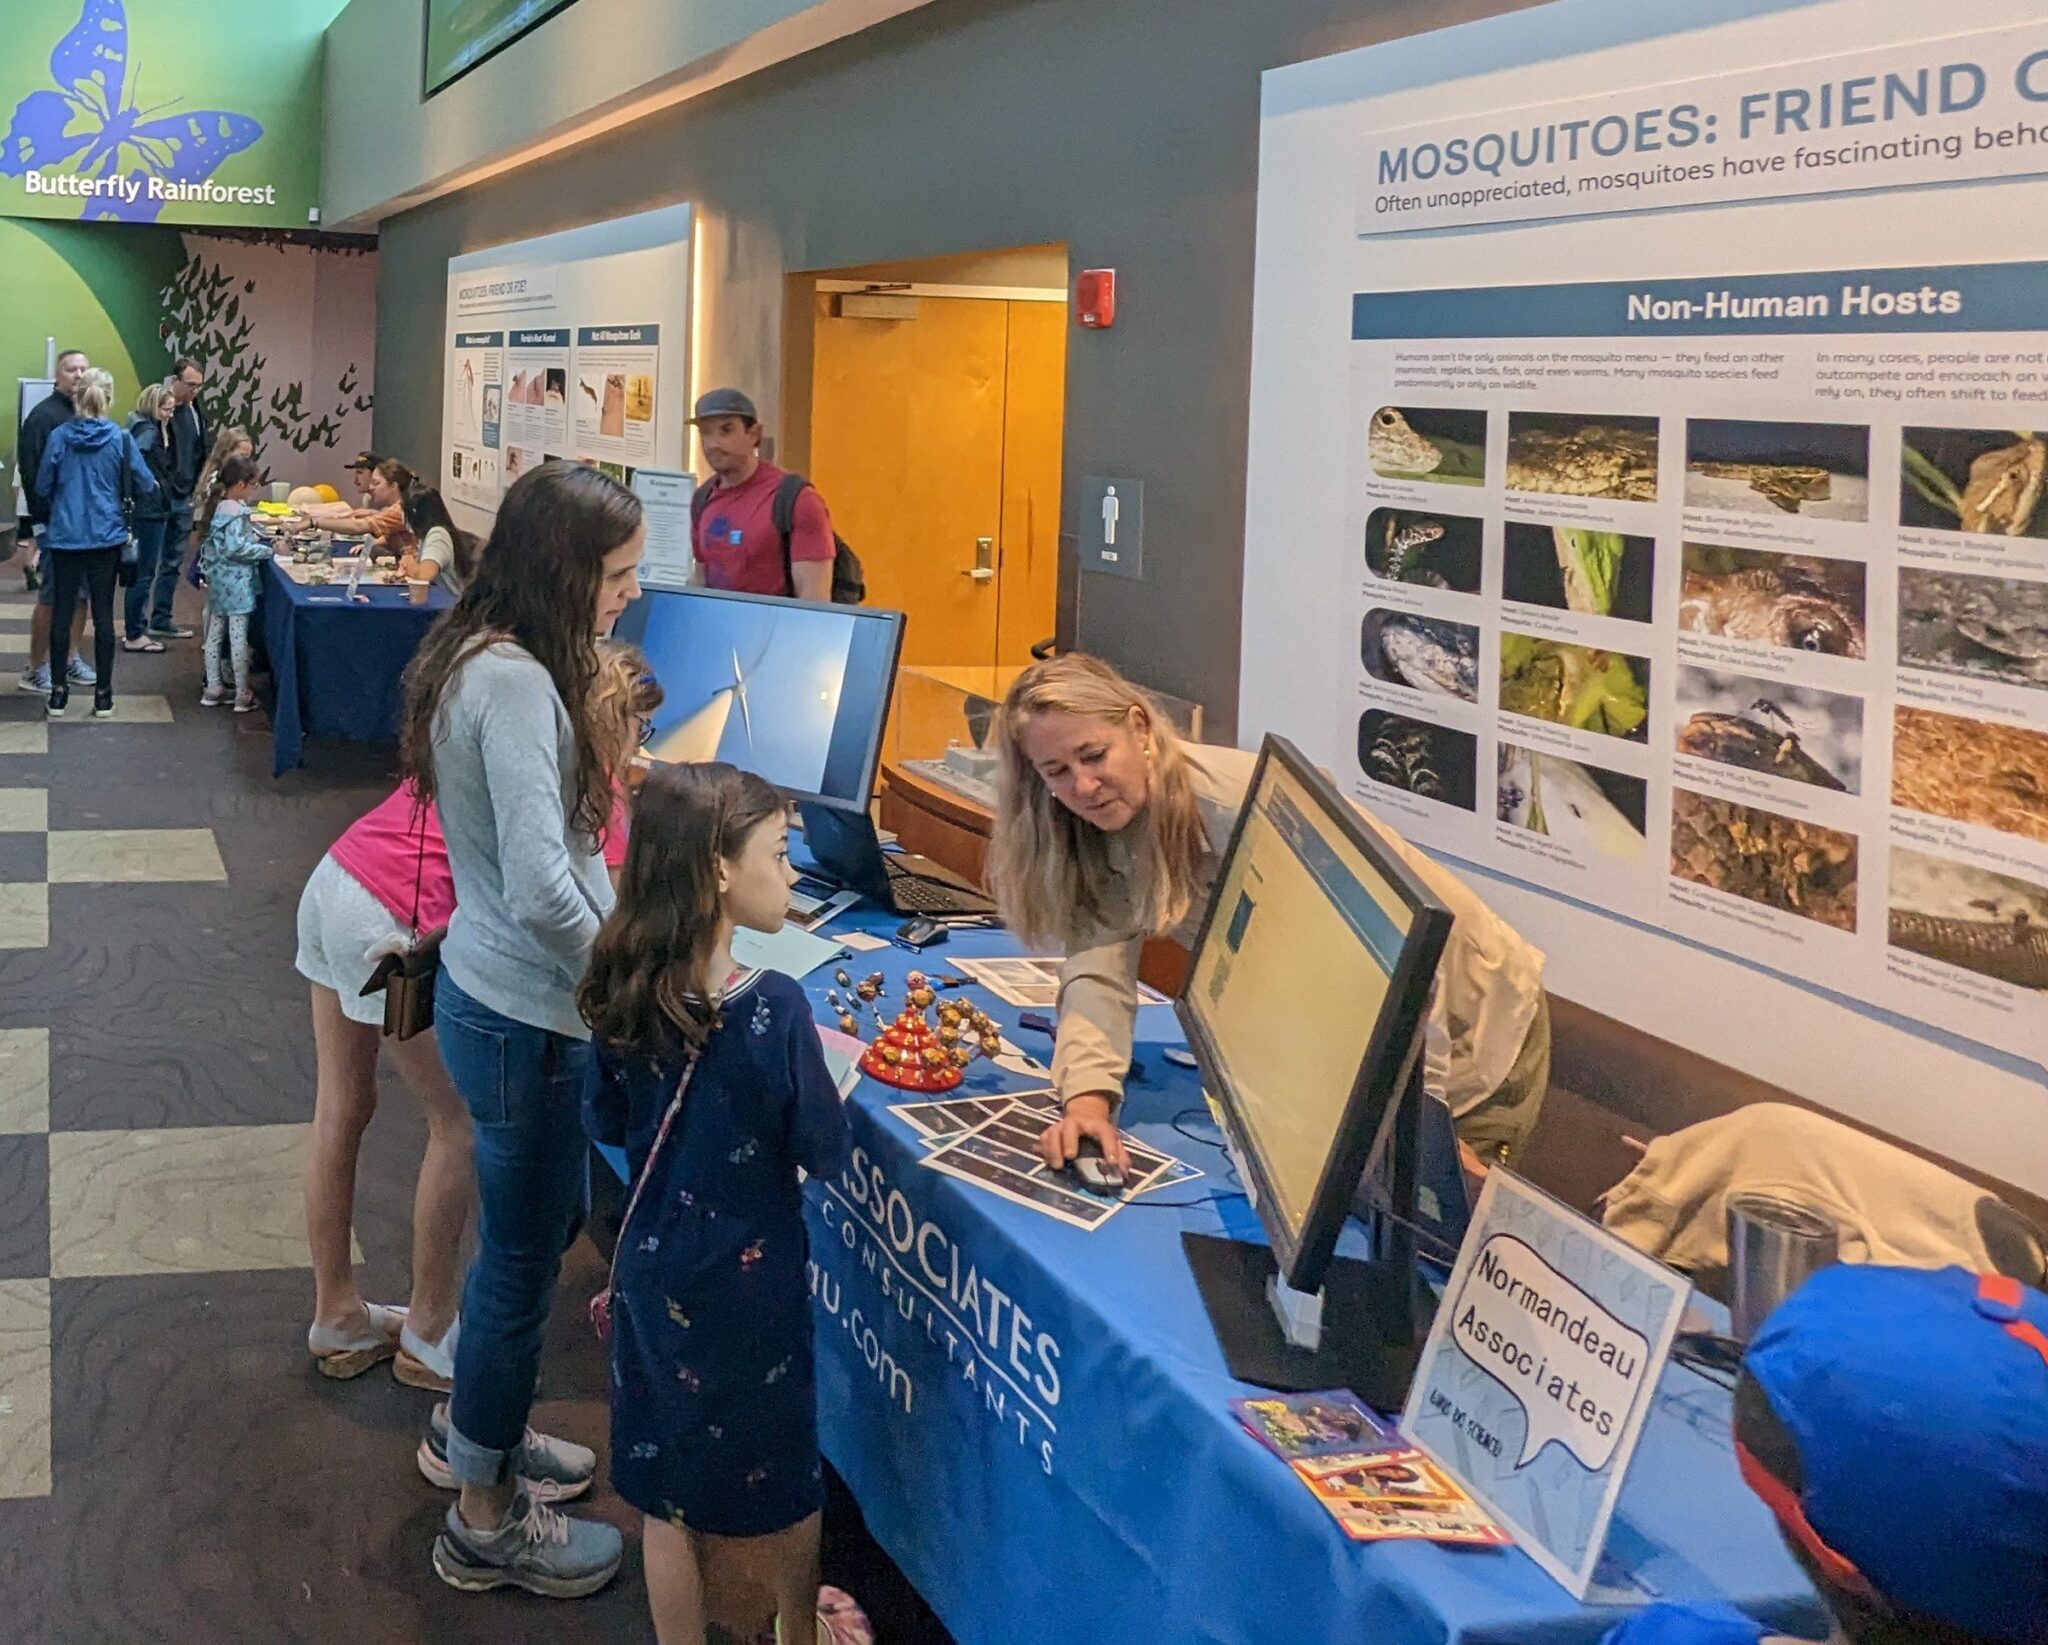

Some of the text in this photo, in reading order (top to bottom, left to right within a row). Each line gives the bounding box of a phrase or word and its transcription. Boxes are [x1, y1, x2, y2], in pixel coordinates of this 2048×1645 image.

[1376, 104, 1718, 185] MOSQUITOES:
[1740, 61, 1987, 139] FRIEND
[24, 169, 276, 207] Butterfly Rainforest
[1375, 191, 1423, 215] Often
[1426, 174, 1572, 210] unappreciated,
[1577, 157, 1714, 193] mosquitoes
[1722, 154, 1786, 178] have
[1794, 132, 1962, 170] fascinating
[1626, 284, 1963, 322] Non-Human Hosts
[1395, 352, 1430, 363] Humans
[1431, 352, 1456, 363] aren't
[1458, 352, 1473, 362] the
[1474, 353, 1494, 365] only
[1496, 353, 1534, 363] animals
[1536, 355, 1549, 363] on
[1552, 352, 1568, 363] the
[1570, 353, 1623, 365] mosquito
[1625, 354, 1657, 363] menu
[1675, 353, 1700, 366] they
[1704, 353, 1729, 363] feed
[1732, 355, 1748, 363] on
[1751, 353, 1785, 363] other
[1475, 367, 1500, 377] birds,
[1502, 367, 1522, 376] fish,
[1524, 367, 1544, 377] and
[1546, 369, 1570, 377] even
[1573, 369, 1610, 378] worms.
[1614, 367, 1645, 380] Many
[1648, 368, 1701, 380] mosquito
[1704, 369, 1748, 380] species
[1751, 368, 1778, 379] feed
[1815, 369, 2038, 383] outcompete and encroach on
[1816, 352, 2042, 366] In many cases, people are not
[1467, 380, 1487, 390] only
[1815, 386, 1841, 399] rely
[1844, 388, 1865, 399] on,
[1869, 387, 1901, 401] they
[1906, 387, 1946, 399] often
[1950, 387, 1986, 400] shift
[1990, 388, 2007, 400] to
[1477, 1249, 1636, 1380] Normandeau
[822, 1200, 1054, 1476] CONSULTANTS
[1458, 1304, 1614, 1437] Associates
